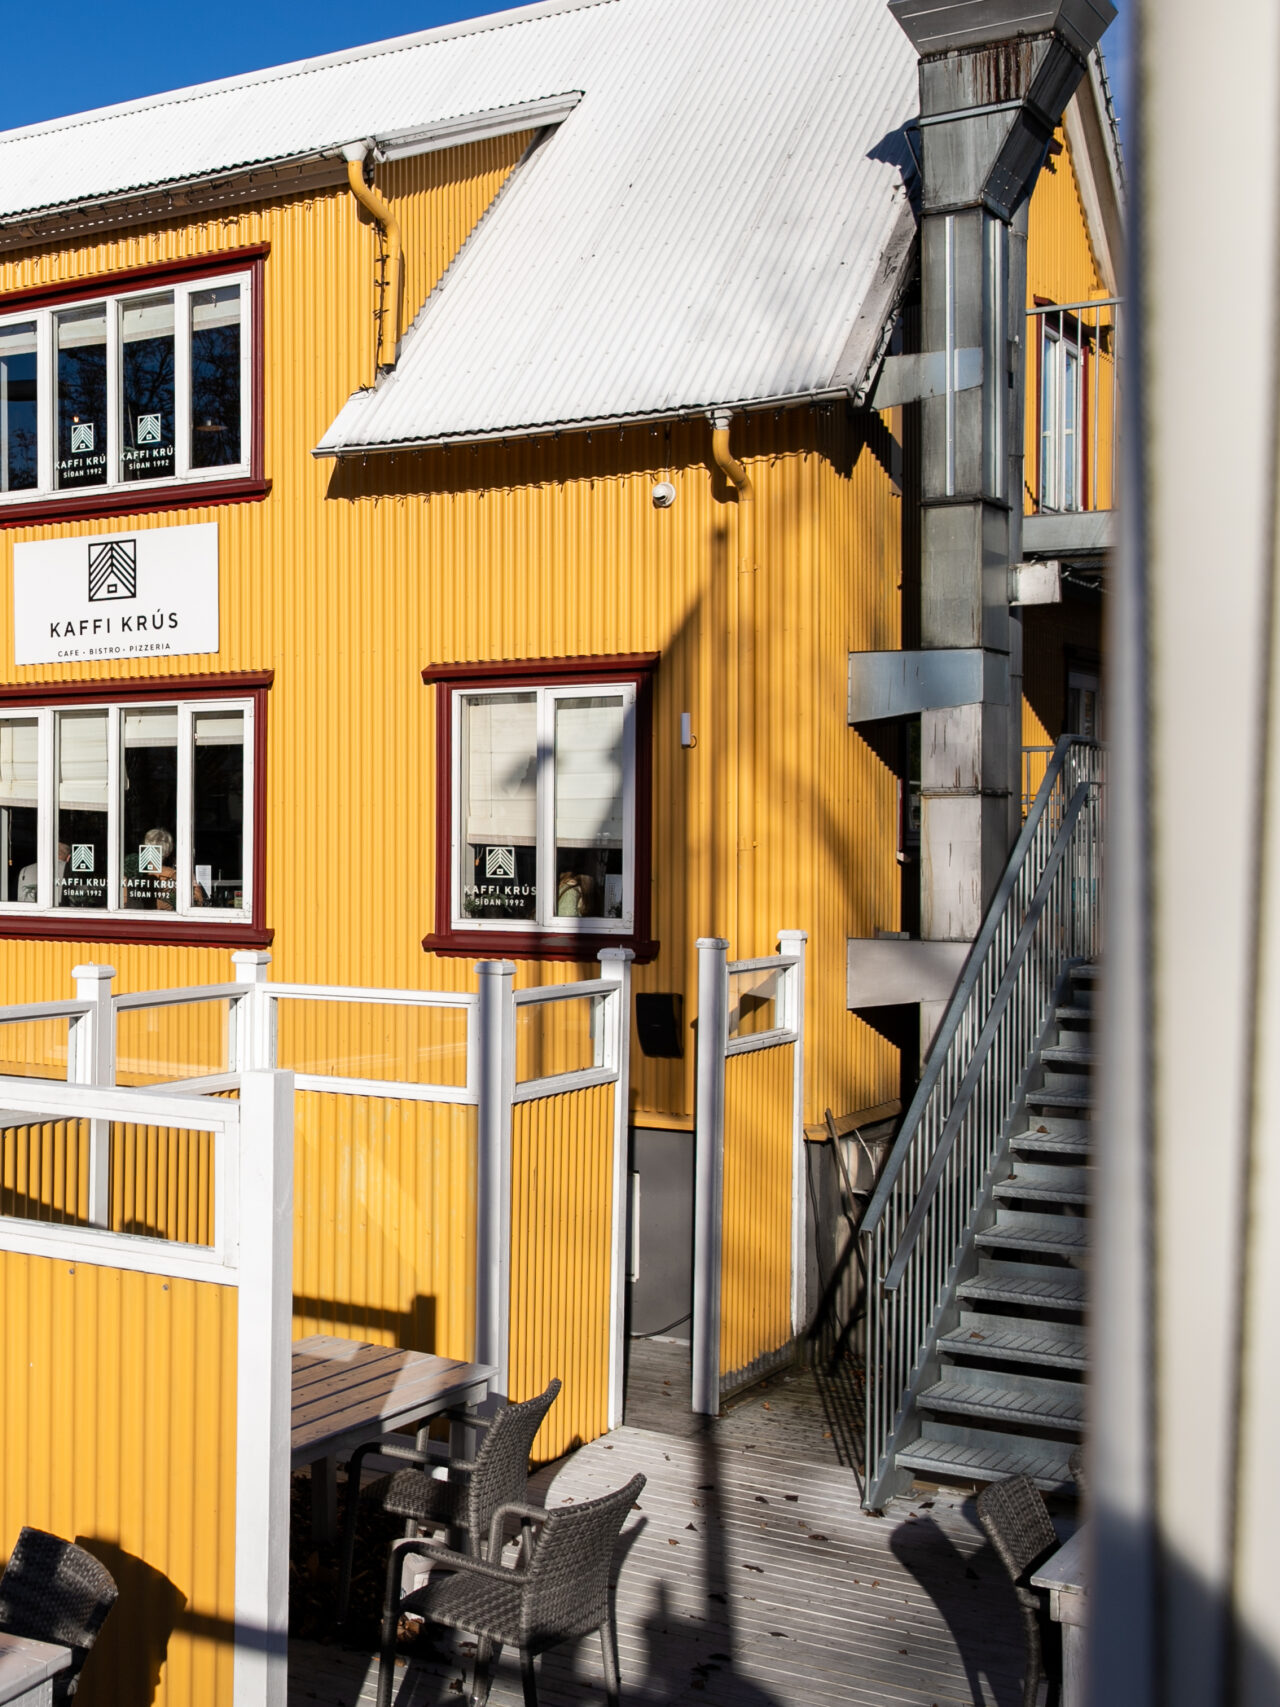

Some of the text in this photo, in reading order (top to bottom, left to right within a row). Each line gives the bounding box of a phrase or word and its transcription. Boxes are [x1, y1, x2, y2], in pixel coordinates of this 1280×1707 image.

[119, 444, 175, 461] KAFFI KRÚ
[54, 453, 107, 470] KAFFI KRÚ
[153, 459, 169, 468] 1992
[50, 608, 179, 638] KAFFI KRÚS
[57, 643, 171, 658] CAFE BISTRO PIZZERIA
[55, 878, 83, 886] KAFFI
[120, 879, 150, 888] KAFFI
[154, 891, 170, 899] 1992
[463, 883, 536, 896] KAFFI KRÚS
[505, 899, 525, 907] 1992
